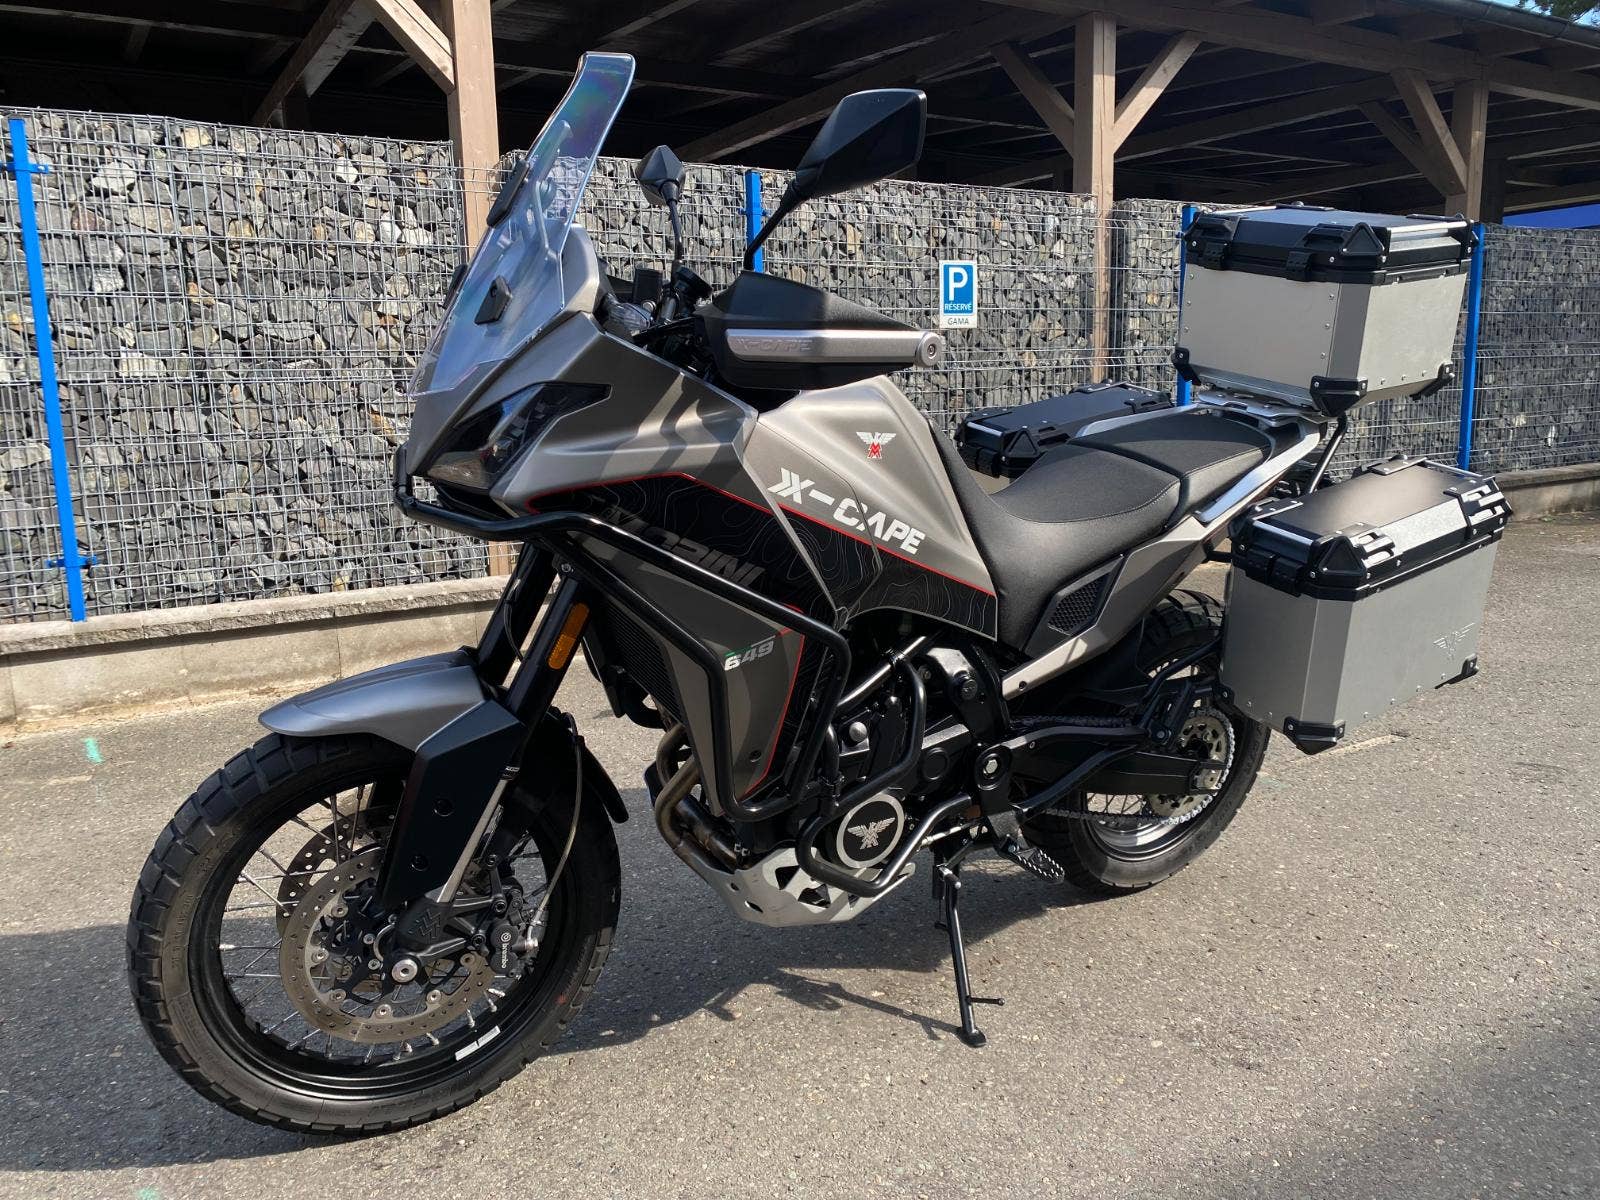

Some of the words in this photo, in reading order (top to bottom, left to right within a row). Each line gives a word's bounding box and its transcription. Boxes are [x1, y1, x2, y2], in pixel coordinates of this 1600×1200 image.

[948, 266, 968, 301] P
[947, 317, 969, 325] GAMA
[767, 467, 926, 555] X-CAPE
[724, 641, 774, 671] 649
